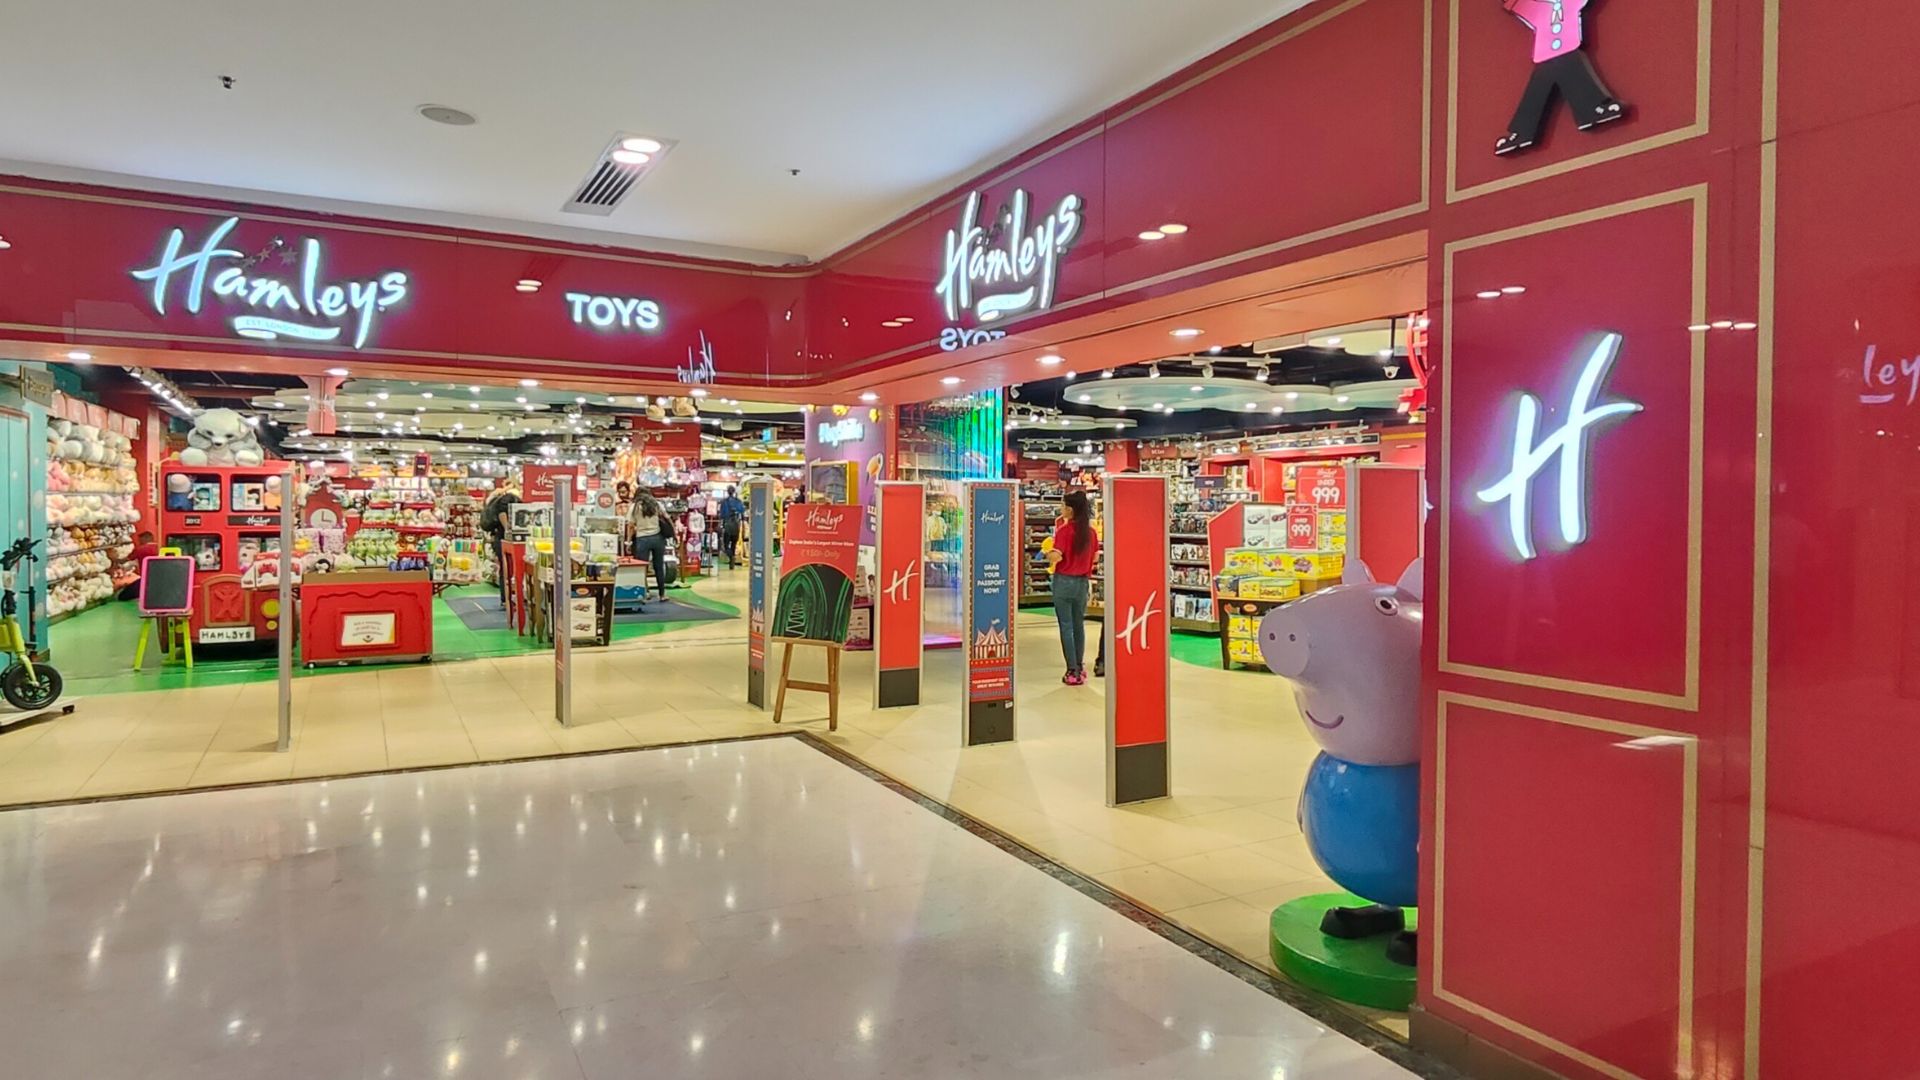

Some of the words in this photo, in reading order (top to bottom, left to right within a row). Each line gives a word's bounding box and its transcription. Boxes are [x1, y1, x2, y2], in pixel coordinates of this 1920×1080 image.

[936, 188, 1079, 321] Hamleys
[132, 216, 407, 350] Hamleys
[565, 292, 660, 330] TOYS
[1476, 332, 1644, 559] H
[1312, 486, 1340, 504] 999
[804, 505, 844, 531] Hamleys
[981, 509, 1005, 524] Hamleys
[1291, 524, 1312, 537] 999
[883, 560, 920, 605] H
[1115, 590, 1162, 655] H
